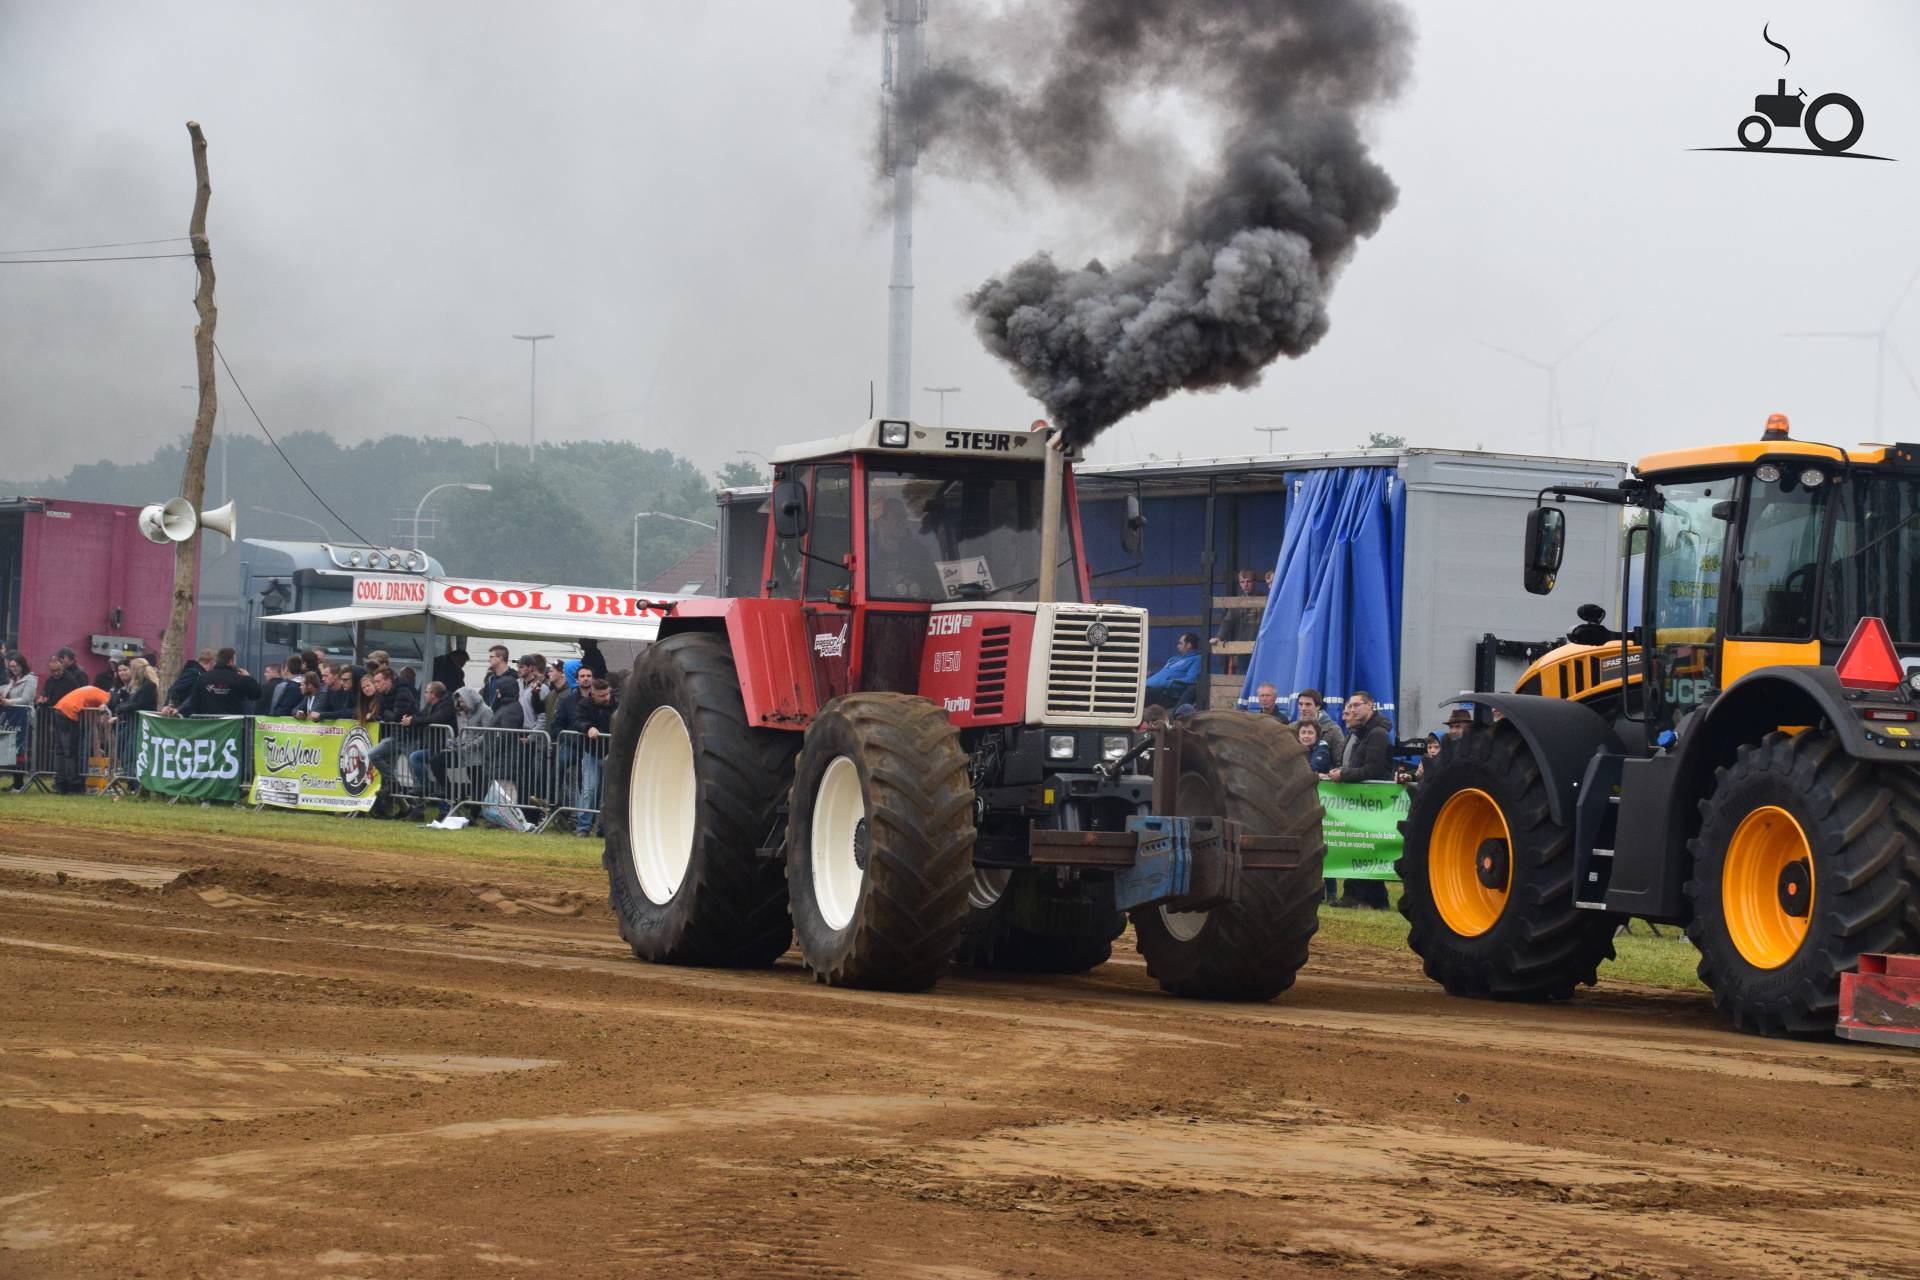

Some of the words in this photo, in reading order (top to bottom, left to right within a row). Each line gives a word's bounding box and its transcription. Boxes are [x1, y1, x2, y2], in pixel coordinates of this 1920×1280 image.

[945, 431, 1010, 451] STEYR
[357, 582, 383, 600] COOL
[386, 582, 425, 602] DRINKS
[443, 585, 552, 610] COOL
[566, 594, 672, 617] DRIN
[928, 614, 962, 636] STEYR
[934, 651, 961, 672] 8150
[1606, 655, 1641, 667] FASAC
[1665, 678, 1713, 704] JCB
[150, 735, 239, 780] TEGELS
[1319, 793, 1383, 812] onwerken
